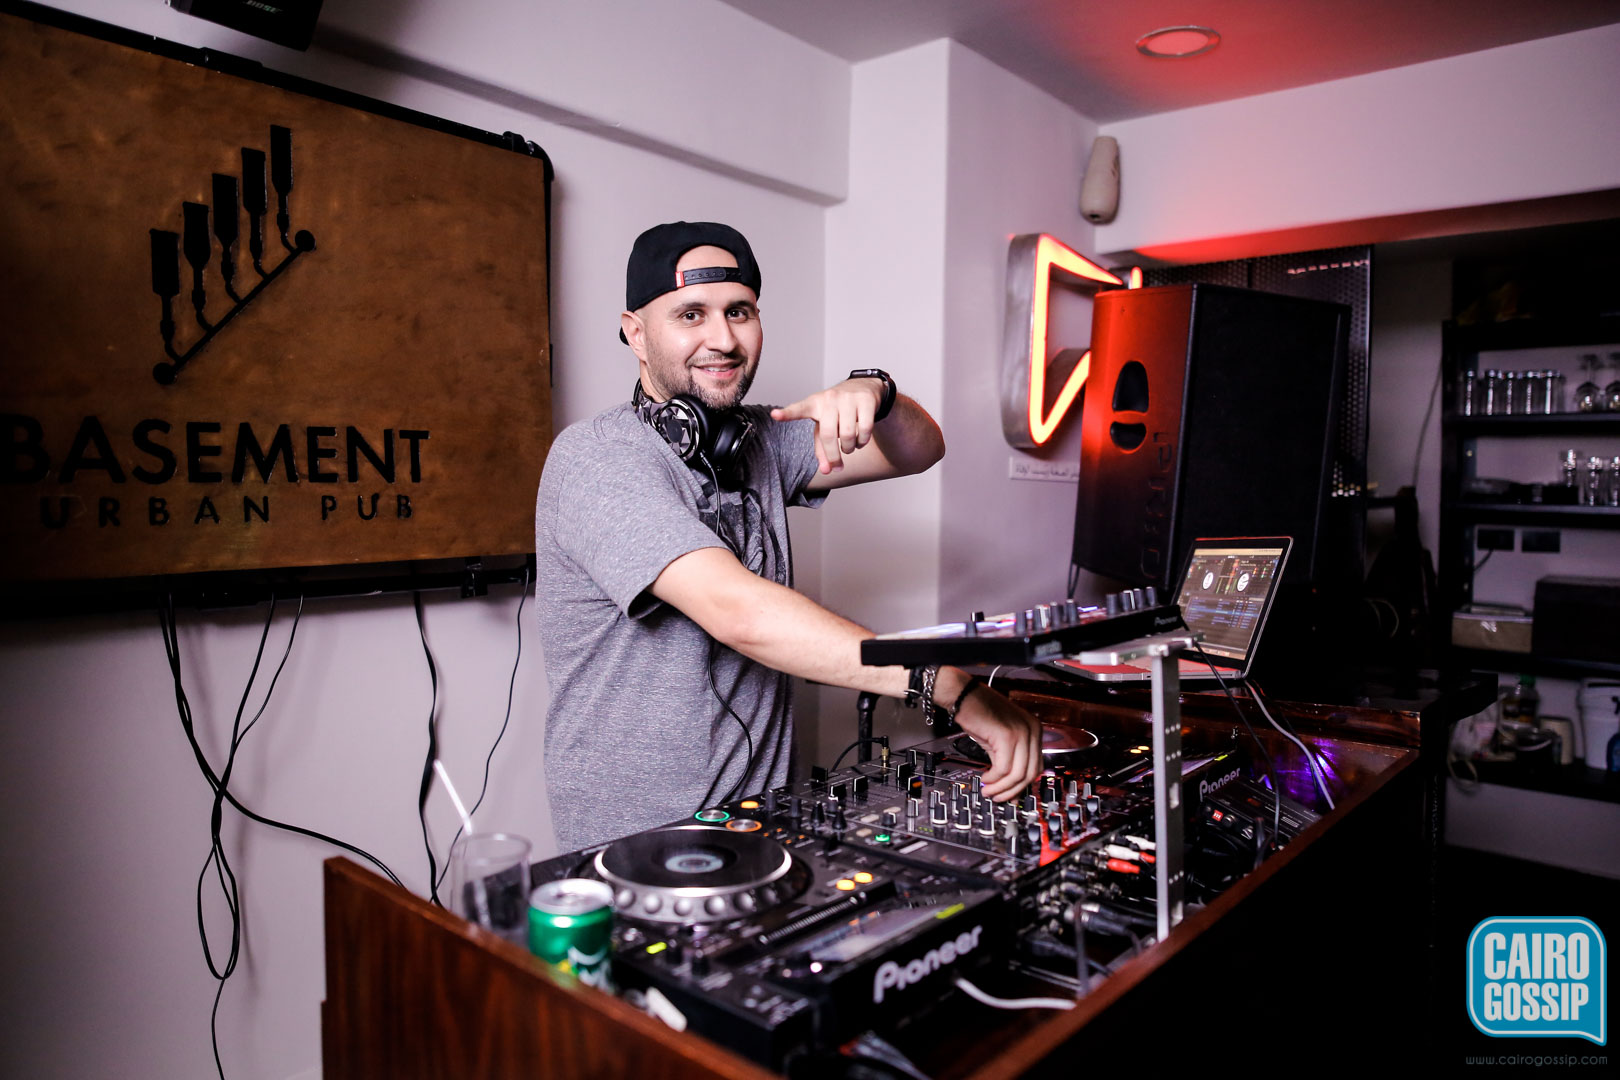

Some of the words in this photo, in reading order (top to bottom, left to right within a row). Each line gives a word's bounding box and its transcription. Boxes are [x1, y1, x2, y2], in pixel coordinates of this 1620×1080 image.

[0, 413, 429, 484] BASEMENT
[40, 496, 270, 530] URBAN
[321, 493, 412, 521] PUB
[1199, 768, 1241, 802] Pioneer
[873, 925, 983, 1004] Pioneer
